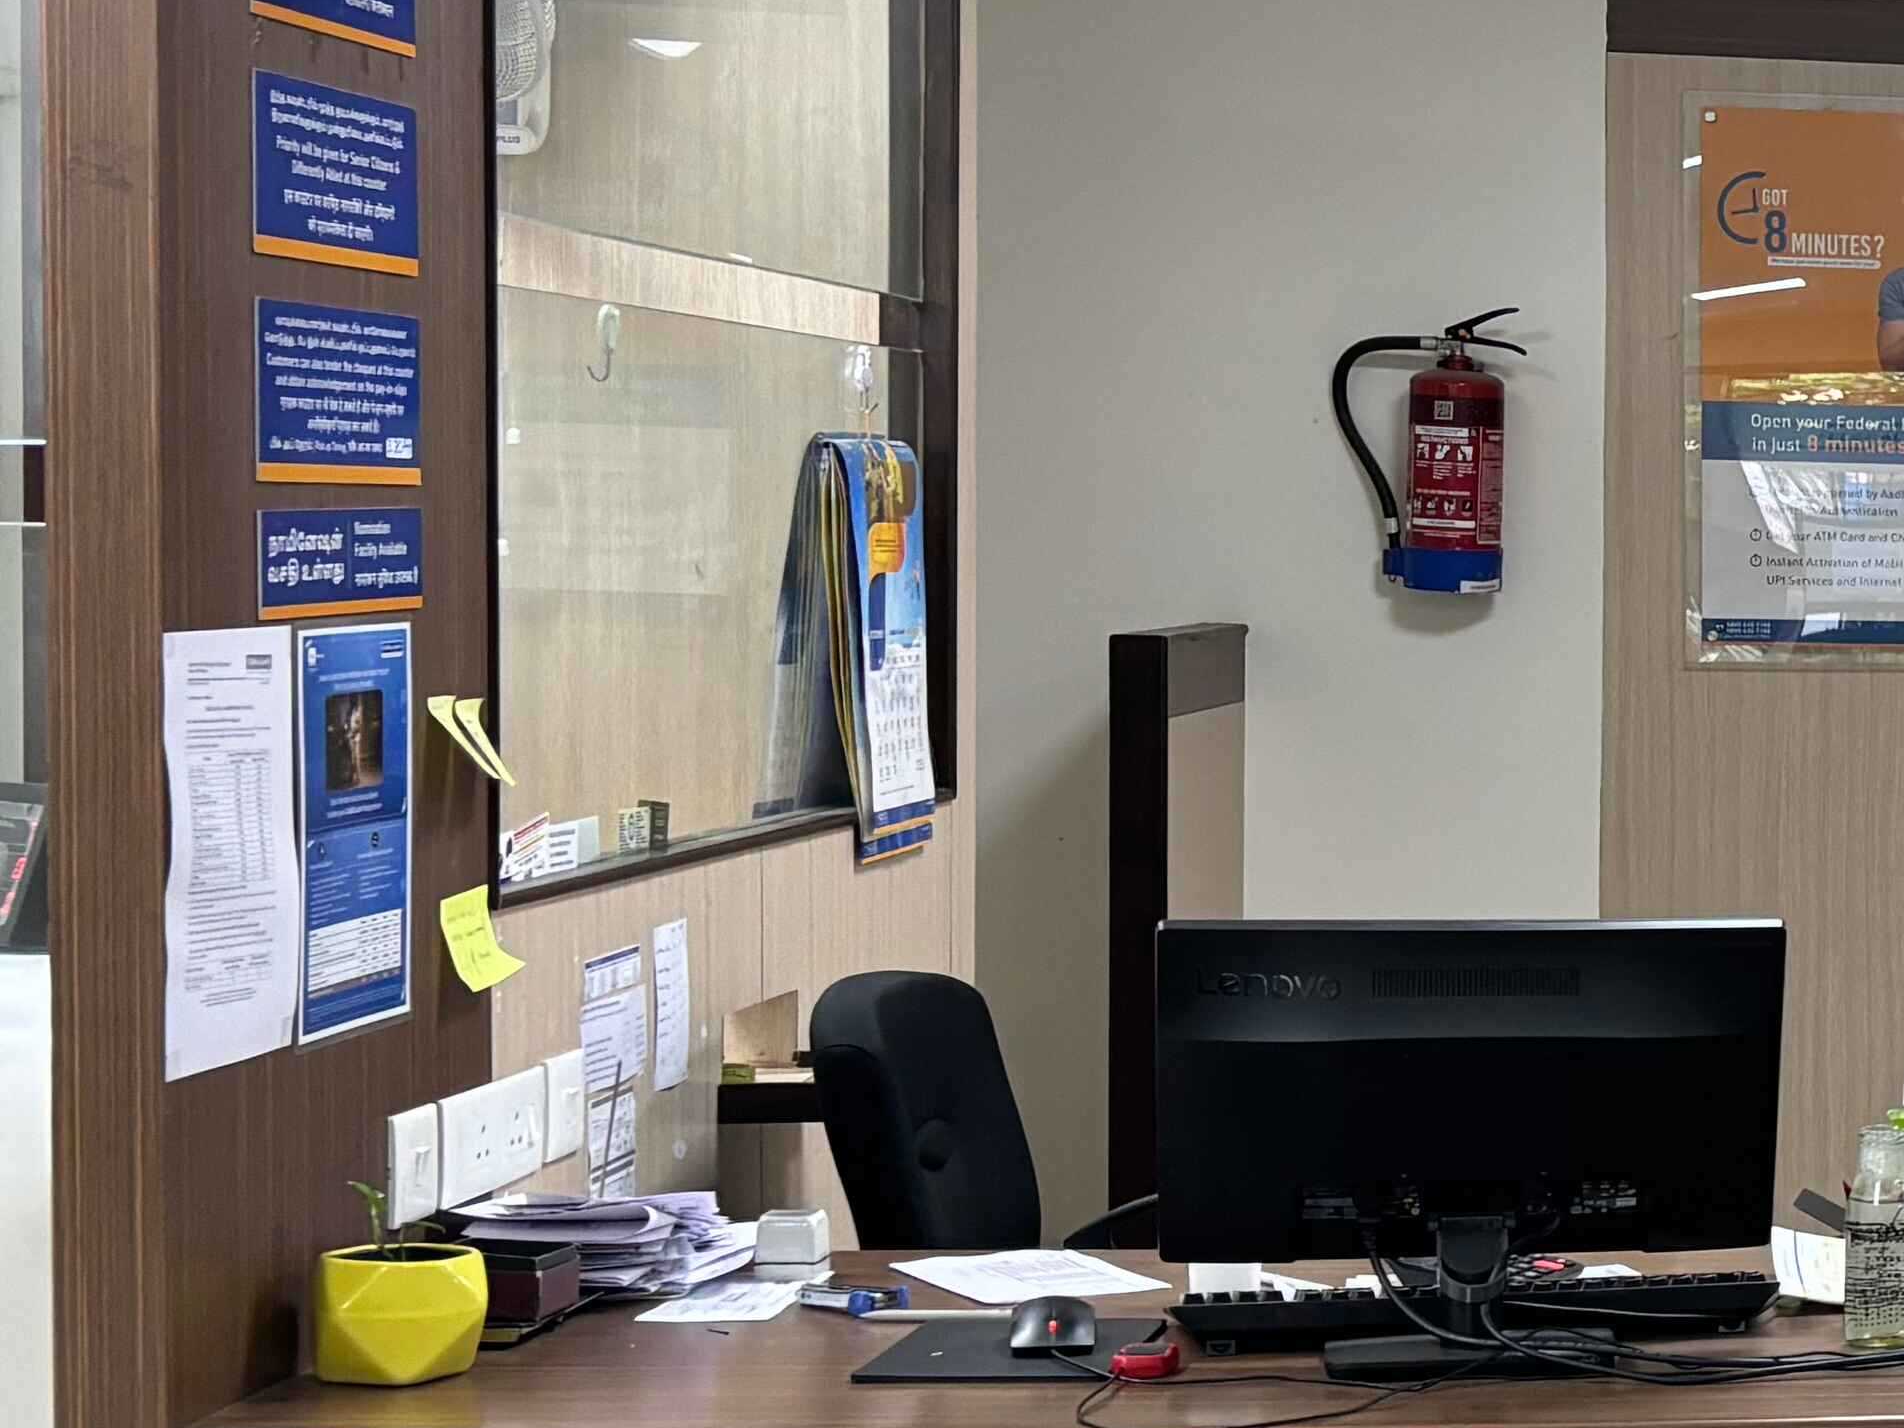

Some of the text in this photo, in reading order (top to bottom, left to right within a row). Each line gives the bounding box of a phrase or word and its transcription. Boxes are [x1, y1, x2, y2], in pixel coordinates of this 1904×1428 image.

[1762, 188, 1788, 206] GOT
[1764, 210, 1787, 253] 8
[1751, 414, 1791, 430] Open
[1796, 419, 1831, 433] your
[1836, 415, 1897, 431] Federal
[1752, 438, 1766, 451] in
[1770, 437, 1800, 454] just
[1807, 435, 1818, 452] 8
[1814, 532, 1837, 541] ATM
[1840, 532, 1865, 542] Card
[1868, 532, 1887, 542] and
[1766, 557, 1803, 567] Instant
[1806, 557, 1859, 568] Activation
[1862, 557, 1872, 568] of
[1766, 575, 1786, 586] UPI
[1788, 576, 1833, 587] Services
[1837, 576, 1856, 587] and
[1859, 577, 1902, 588] Internet
